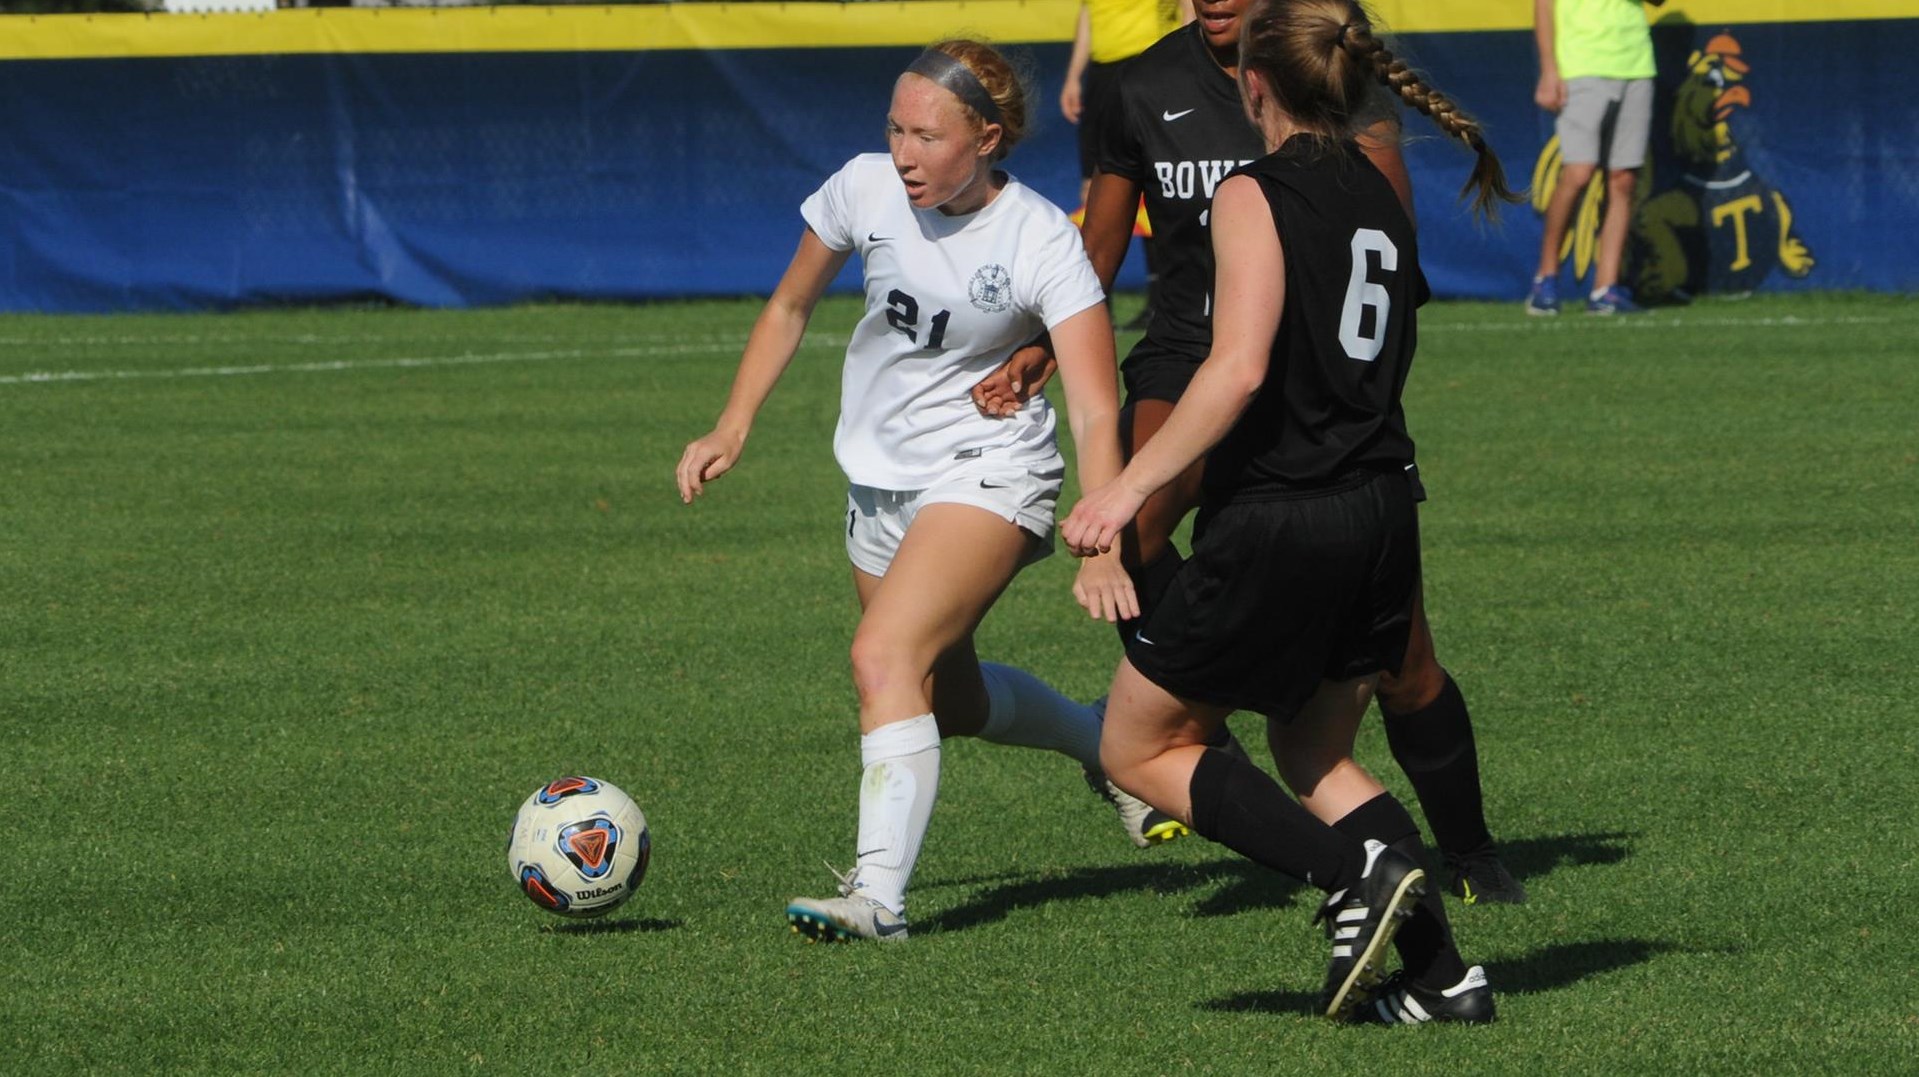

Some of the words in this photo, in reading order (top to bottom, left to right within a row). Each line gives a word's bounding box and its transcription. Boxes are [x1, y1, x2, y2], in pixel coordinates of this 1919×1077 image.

[1154, 159, 1255, 200] BOW
[1711, 194, 1762, 272] T
[886, 288, 951, 349] 21
[1338, 228, 1398, 361] 6
[846, 508, 857, 539] 1
[575, 883, 622, 900] Wilson
